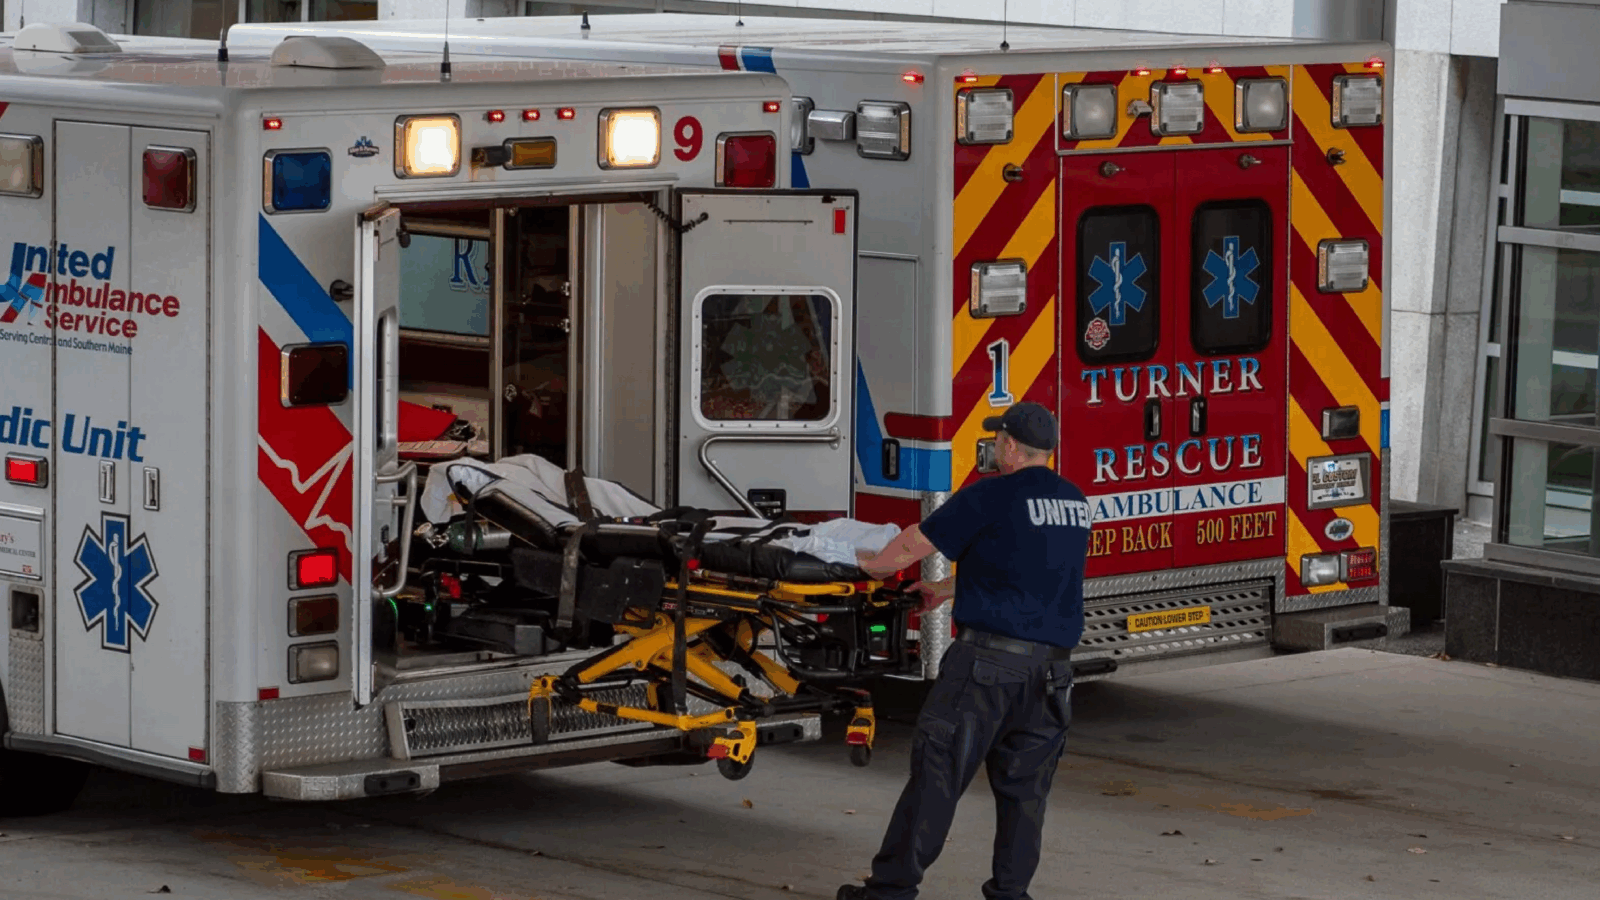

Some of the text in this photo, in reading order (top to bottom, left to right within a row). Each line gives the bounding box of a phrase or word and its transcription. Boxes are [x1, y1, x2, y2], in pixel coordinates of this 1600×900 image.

[673, 115, 703, 162] 9
[450, 238, 489, 292] R
[0, 329, 28, 345] Serving
[58, 337, 73, 348] and
[73, 337, 107, 352] Southern
[108, 341, 133, 355] Maine
[44, 304, 138, 338] Service
[987, 337, 1014, 407] 1
[1081, 356, 1264, 405] TURNER
[0, 406, 146, 462] dic Unit
[1093, 434, 1263, 484] RESCUE
[1026, 498, 1092, 529] UNITED
[1092, 481, 1263, 522] AMBULANCE
[0, 533, 15, 545] ry's
[1121, 521, 1174, 554] BACK
[1196, 517, 1225, 545] 500
[1229, 510, 1277, 541] FEET
[1187, 610, 1204, 622] STEP
